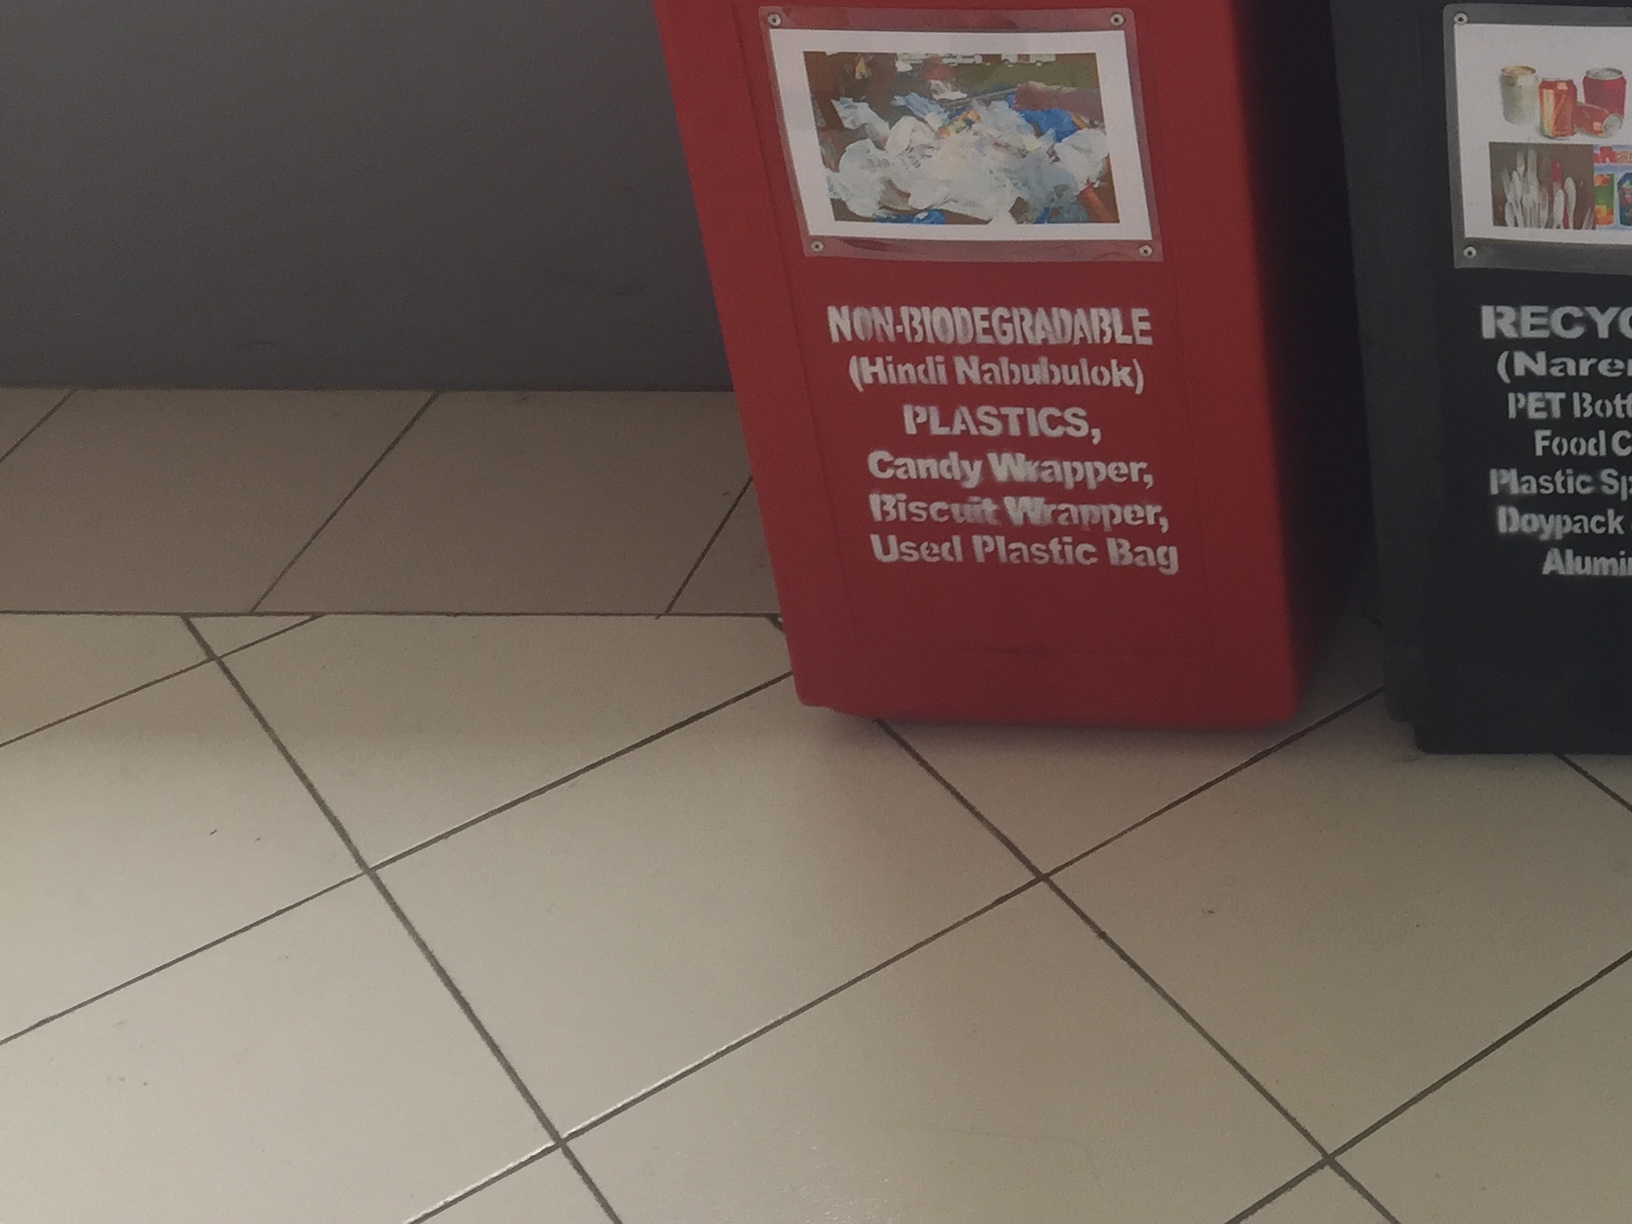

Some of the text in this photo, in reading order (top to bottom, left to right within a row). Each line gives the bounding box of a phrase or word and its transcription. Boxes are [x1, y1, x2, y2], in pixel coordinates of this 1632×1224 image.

[827, 305, 1154, 345] NON-BIODEGRADABLE
[848, 355, 1145, 394] (Hindi Nabubulok)
[903, 404, 1101, 444] PLASTICS,
[1508, 392, 1566, 419] PET
[1534, 429, 1606, 456] Food
[867, 450, 1154, 489] Candy Wrapper,
[1490, 468, 1594, 495] Plastic
[869, 493, 1169, 533] Biscuit Wrapper,
[1496, 506, 1624, 541] Doypack
[869, 533, 1180, 575] Used Plastic Bag
